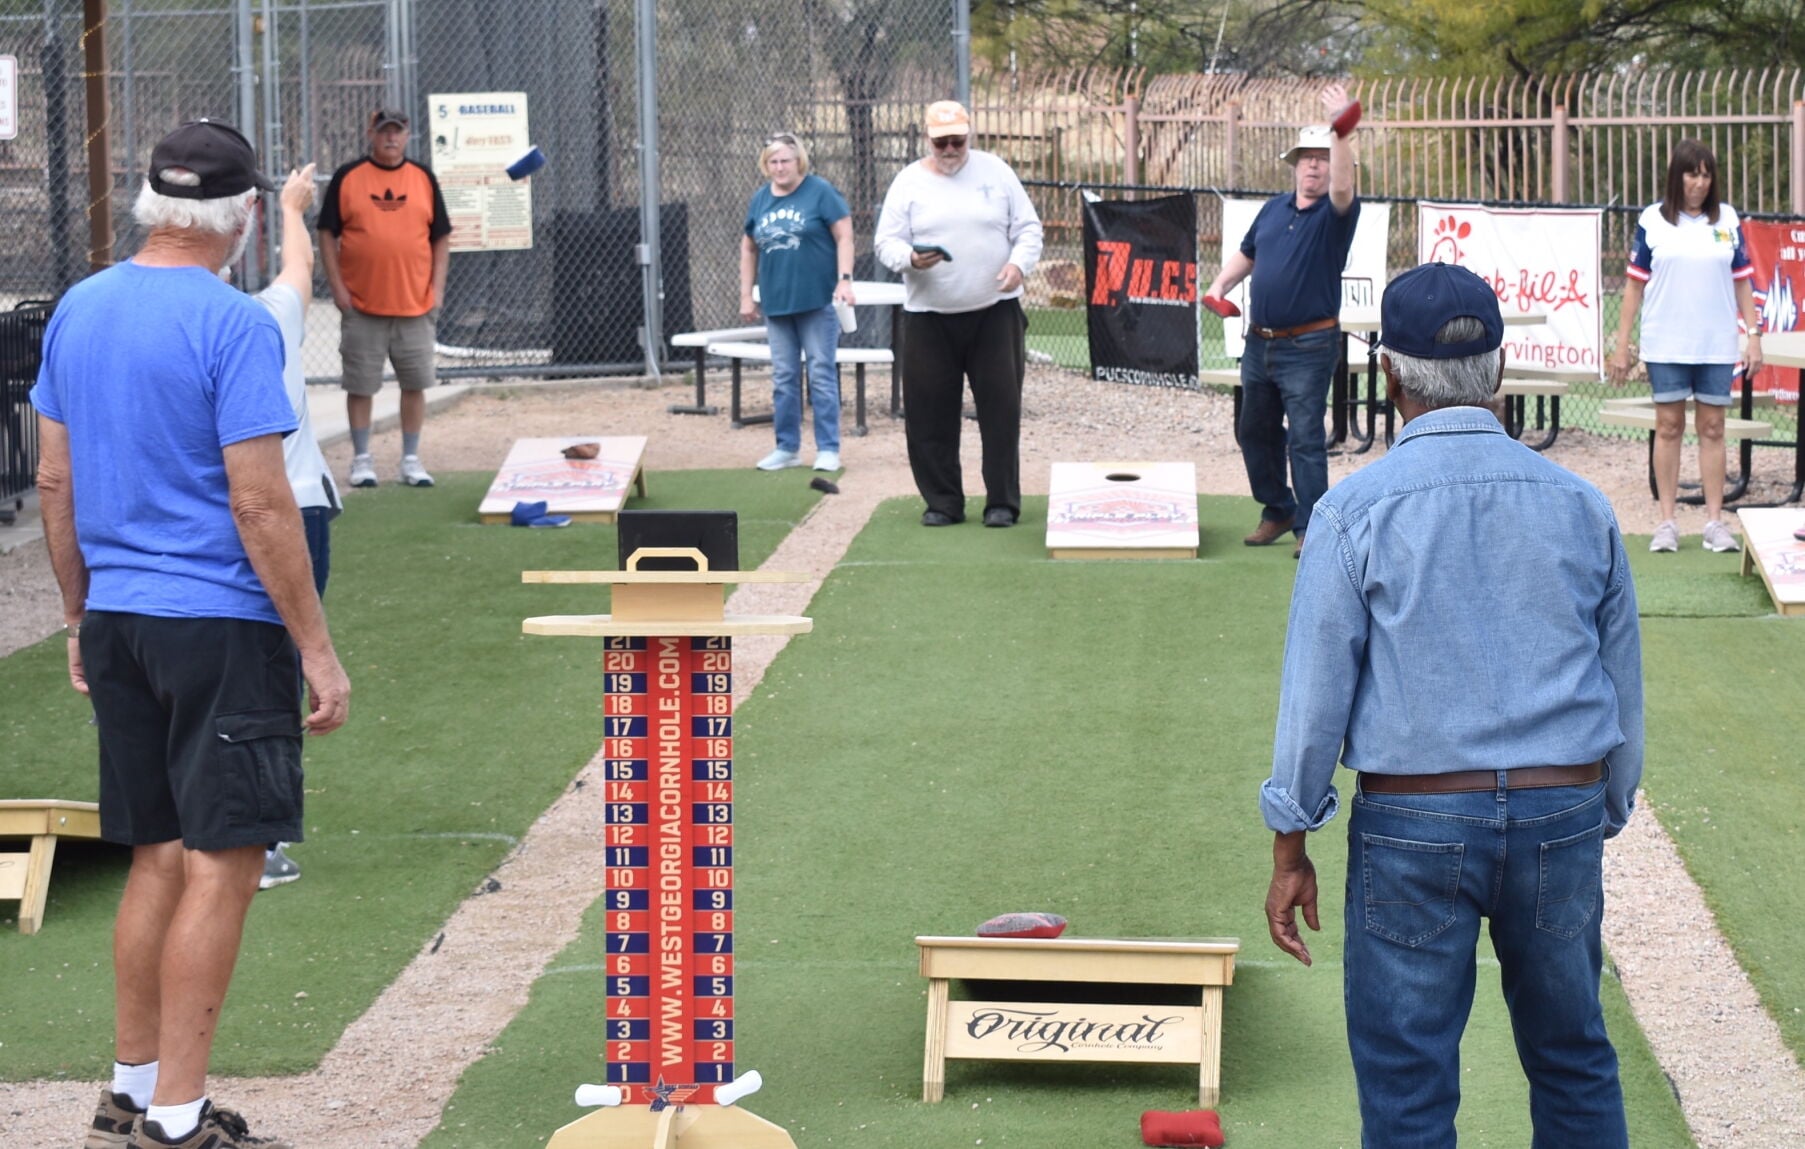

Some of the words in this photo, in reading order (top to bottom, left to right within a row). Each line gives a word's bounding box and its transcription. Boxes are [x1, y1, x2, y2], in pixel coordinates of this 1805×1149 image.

[438, 105, 447, 118] 5
[458, 104, 516, 115] BASEBALL
[1504, 336, 1594, 368] rvington
[611, 637, 631, 648] 21
[706, 637, 726, 648] 21
[608, 653, 634, 671] 20
[704, 653, 730, 671] 20
[611, 675, 632, 692] 19
[707, 675, 728, 692] 19
[611, 696, 632, 714] 18
[707, 696, 728, 714] 18
[611, 718, 632, 735] 17
[707, 718, 728, 735] 17
[612, 740, 633, 757] 16
[707, 740, 729, 757] 16
[612, 761, 633, 779] 15
[707, 761, 729, 779] 15
[612, 783, 633, 800] 14
[707, 783, 729, 800] 14
[612, 805, 633, 822] 13
[707, 805, 729, 822] 13
[612, 827, 633, 844] 12
[707, 827, 729, 844] 12
[616, 848, 630, 865] 11
[659, 637, 682, 1067] WWW.WESTGEORGIACORNHOLE.COM
[711, 848, 725, 865] 11
[613, 869, 633, 887] 10
[708, 869, 728, 887] 10
[617, 891, 631, 909] 9
[712, 891, 726, 909] 9
[617, 913, 631, 930] 8
[712, 913, 726, 930] 8
[617, 935, 631, 952] 7
[712, 935, 726, 952] 7
[617, 956, 631, 974] 6
[712, 956, 726, 974] 6
[617, 978, 631, 995] 5
[712, 978, 726, 995] 5
[617, 999, 631, 1016] 4
[712, 999, 726, 1016] 4
[617, 1021, 631, 1038] 3
[712, 1021, 726, 1038] 3
[965, 1008, 1184, 1052] Original
[617, 1042, 631, 1060] 2
[712, 1042, 726, 1060] 2
[1071, 1041, 1115, 1050] Cornhole
[1116, 1042, 1164, 1051] Company
[620, 1064, 628, 1081] 1
[716, 1064, 723, 1081] 1
